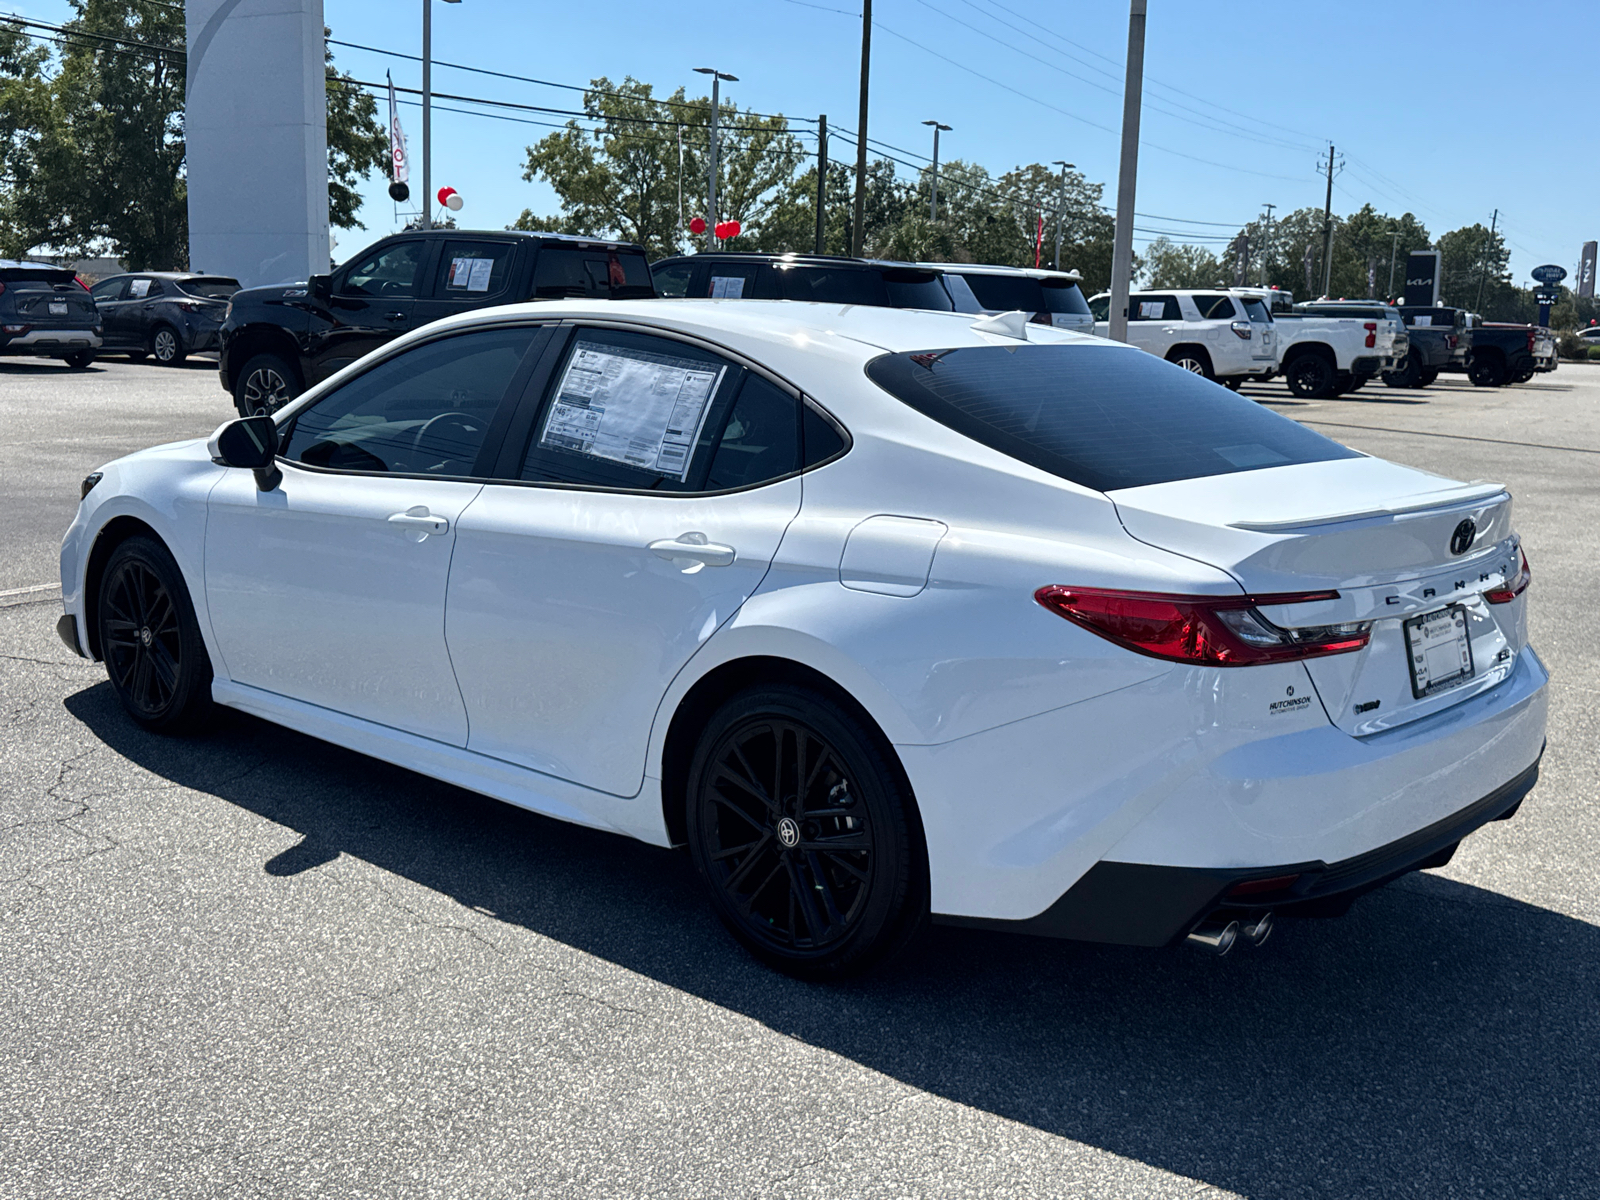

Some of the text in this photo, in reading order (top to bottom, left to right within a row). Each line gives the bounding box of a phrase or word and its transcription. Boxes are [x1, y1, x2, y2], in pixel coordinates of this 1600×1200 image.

[1406, 278, 1433, 286] KIA
[1385, 564, 1507, 605] CAMRY
[1269, 695, 1311, 710] HUTCHINSON
[1269, 706, 1296, 715] AUTOMOTIVE
